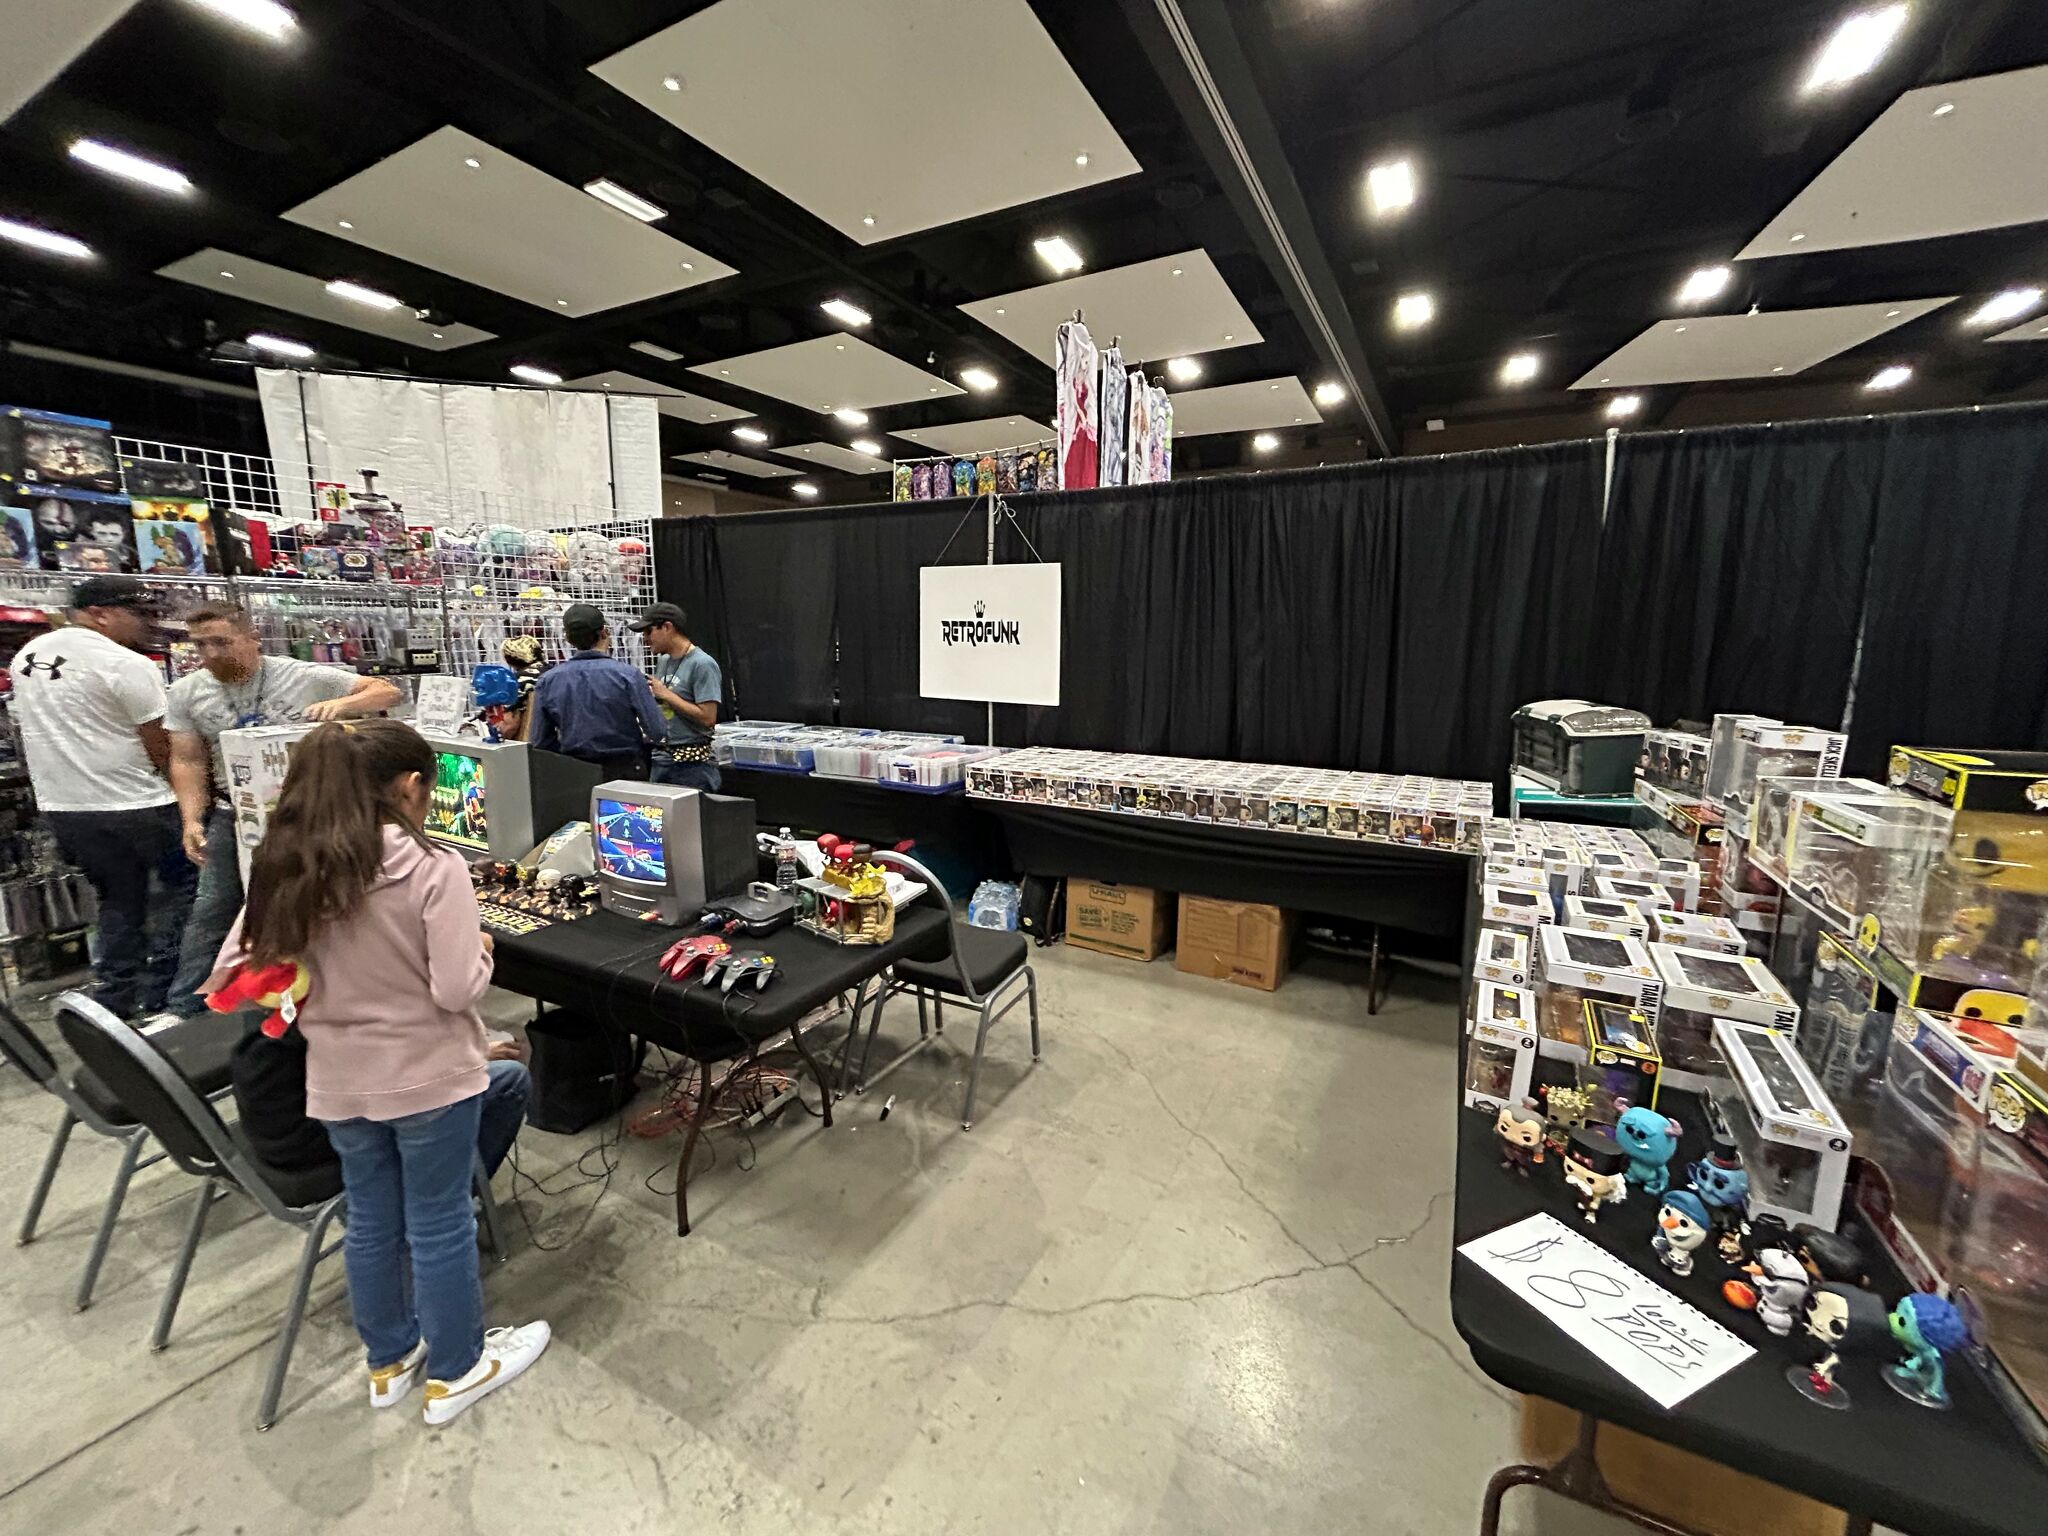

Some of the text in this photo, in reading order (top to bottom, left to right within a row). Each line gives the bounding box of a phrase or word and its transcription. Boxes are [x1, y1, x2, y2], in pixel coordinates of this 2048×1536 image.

[940, 619, 1020, 647] RETROFUNK
[1826, 737, 1844, 755] JACK
[1640, 984, 1660, 1008] TIANA
[1603, 1313, 1703, 1370] POPS
